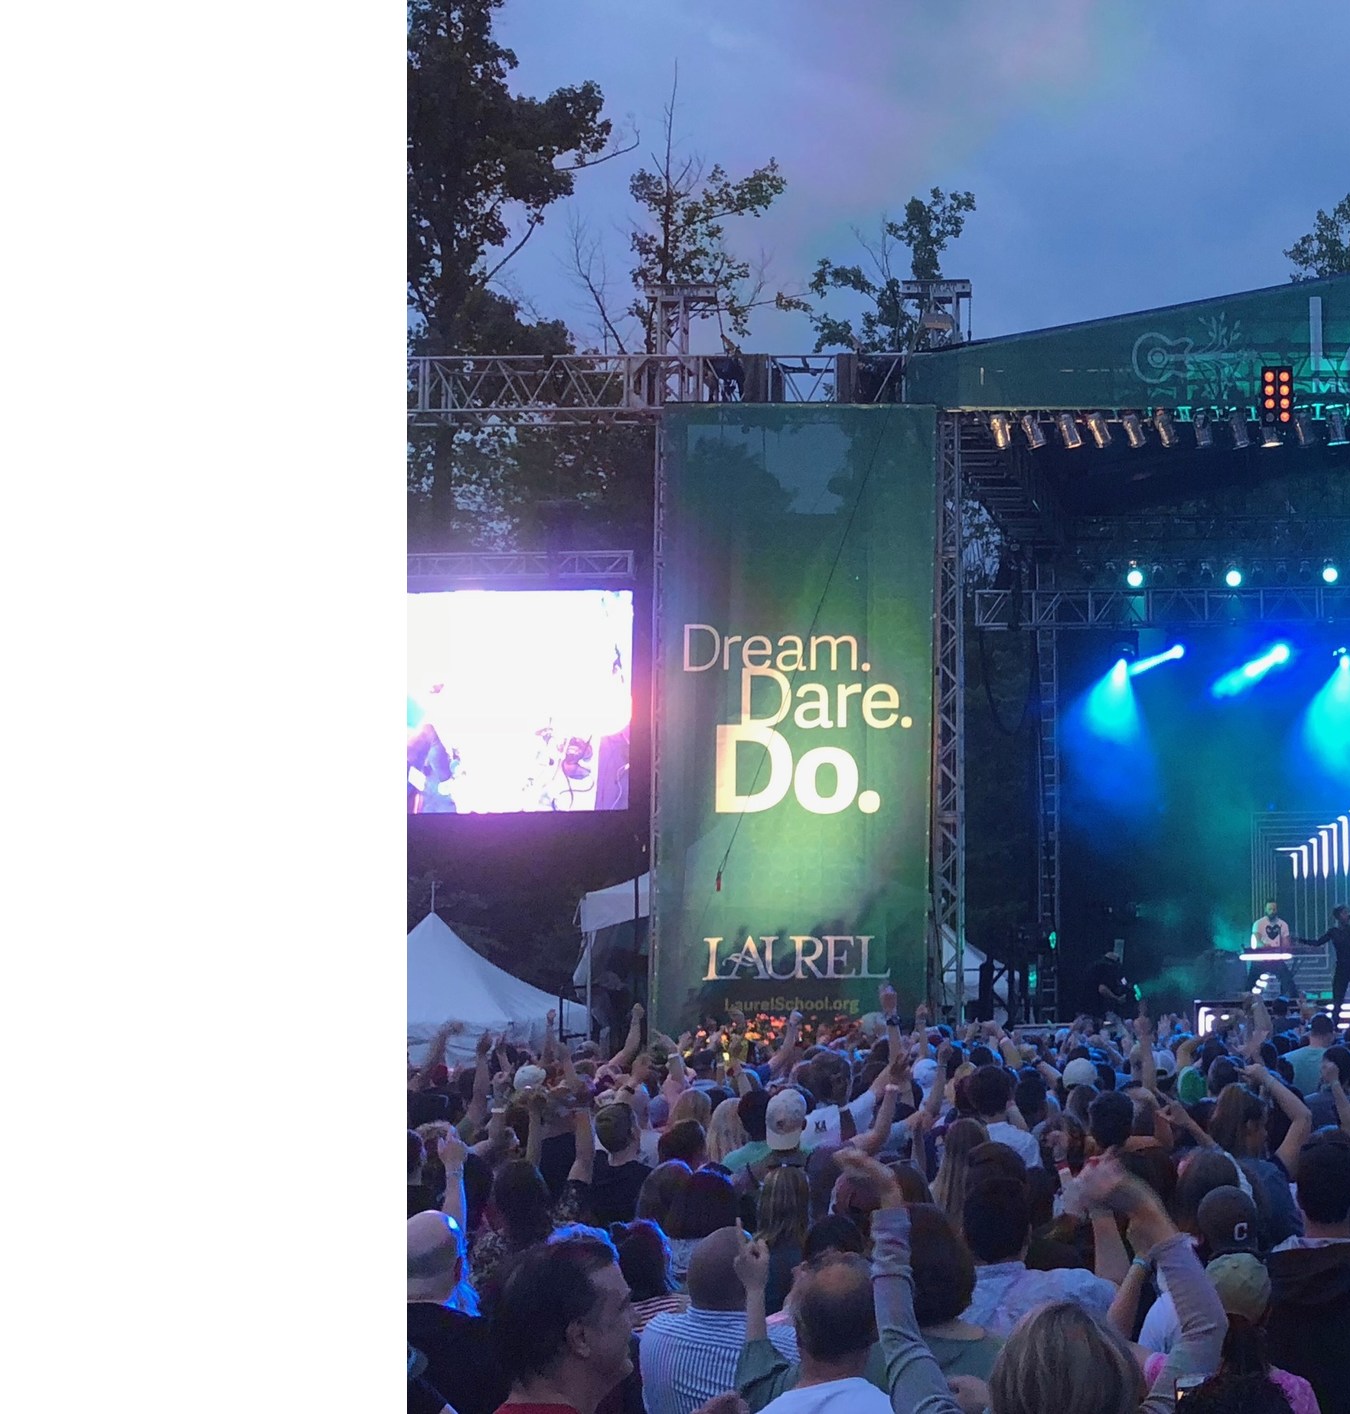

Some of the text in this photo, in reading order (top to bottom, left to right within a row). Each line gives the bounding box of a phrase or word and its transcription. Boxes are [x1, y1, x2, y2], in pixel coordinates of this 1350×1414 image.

[683, 623, 871, 672] Dream.
[741, 667, 913, 729] Dare.
[715, 724, 881, 814] Do.
[702, 934, 891, 981] LAUREL
[1234, 1222, 1249, 1241] C
